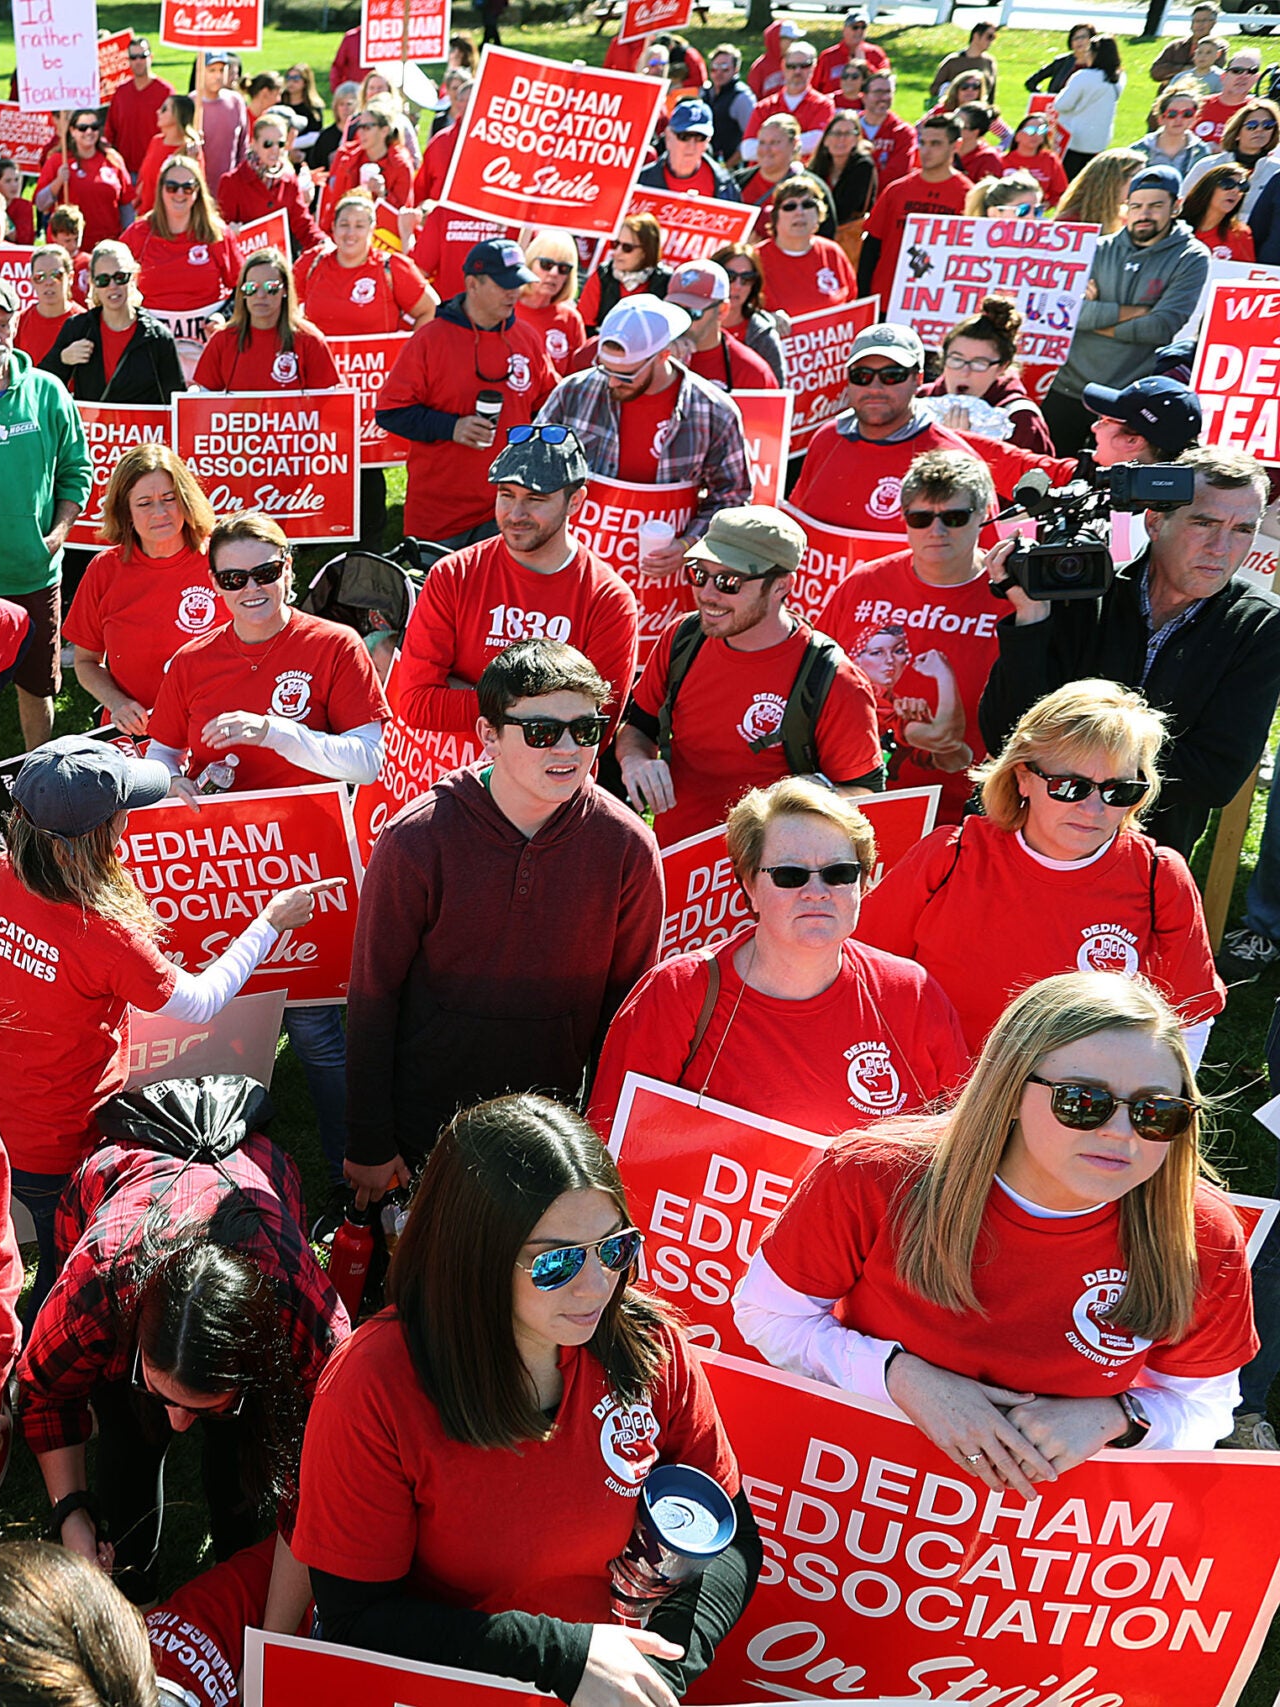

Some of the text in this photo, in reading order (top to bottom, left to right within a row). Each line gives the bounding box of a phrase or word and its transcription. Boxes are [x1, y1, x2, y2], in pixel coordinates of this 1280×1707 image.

[173, 8, 241, 31] On Strike
[21, 26, 83, 49] rather
[367, 38, 441, 59] EDUCTORS
[42, 53, 63, 69] be
[21, 76, 97, 107] teaching!
[510, 76, 622, 117] DEDHAM
[0, 109, 48, 124] DEDHAM
[487, 96, 631, 143] EDUCATION
[470, 118, 635, 168] ASSOCIATION
[482, 156, 600, 201] On Strike
[628, 199, 743, 232] WE SUPPORT
[660, 228, 732, 262] DHAM
[910, 218, 1100, 252] THE OLDEST
[945, 254, 1087, 291] DISTRICT
[901, 286, 945, 312] IN
[783, 321, 854, 357] EDHAM
[211, 411, 320, 433] DEDHAM
[194, 432, 336, 455] EDUCATION
[186, 454, 348, 478] ASSOCIATION
[208, 483, 325, 512] On Strike
[181, 585, 216, 600] DEDHAM
[489, 604, 571, 644] 1839
[854, 599, 998, 639] #RedforE
[485, 637, 517, 648] BOST
[275, 670, 313, 684] DEDHAM
[753, 693, 788, 709] DEDHA
[135, 852, 321, 895] UCATION
[1081, 923, 1138, 945] DEDHAM
[13, 948, 56, 982] LIVES
[1082, 1268, 1128, 1287] DED
[1064, 1331, 1109, 1367] EDUCATION
[800, 1437, 1174, 1548] DEDHAM
[741, 1473, 1215, 1602] EDUCATION
[756, 1535, 1232, 1654] SSOCIATION
[746, 1620, 867, 1693] On
